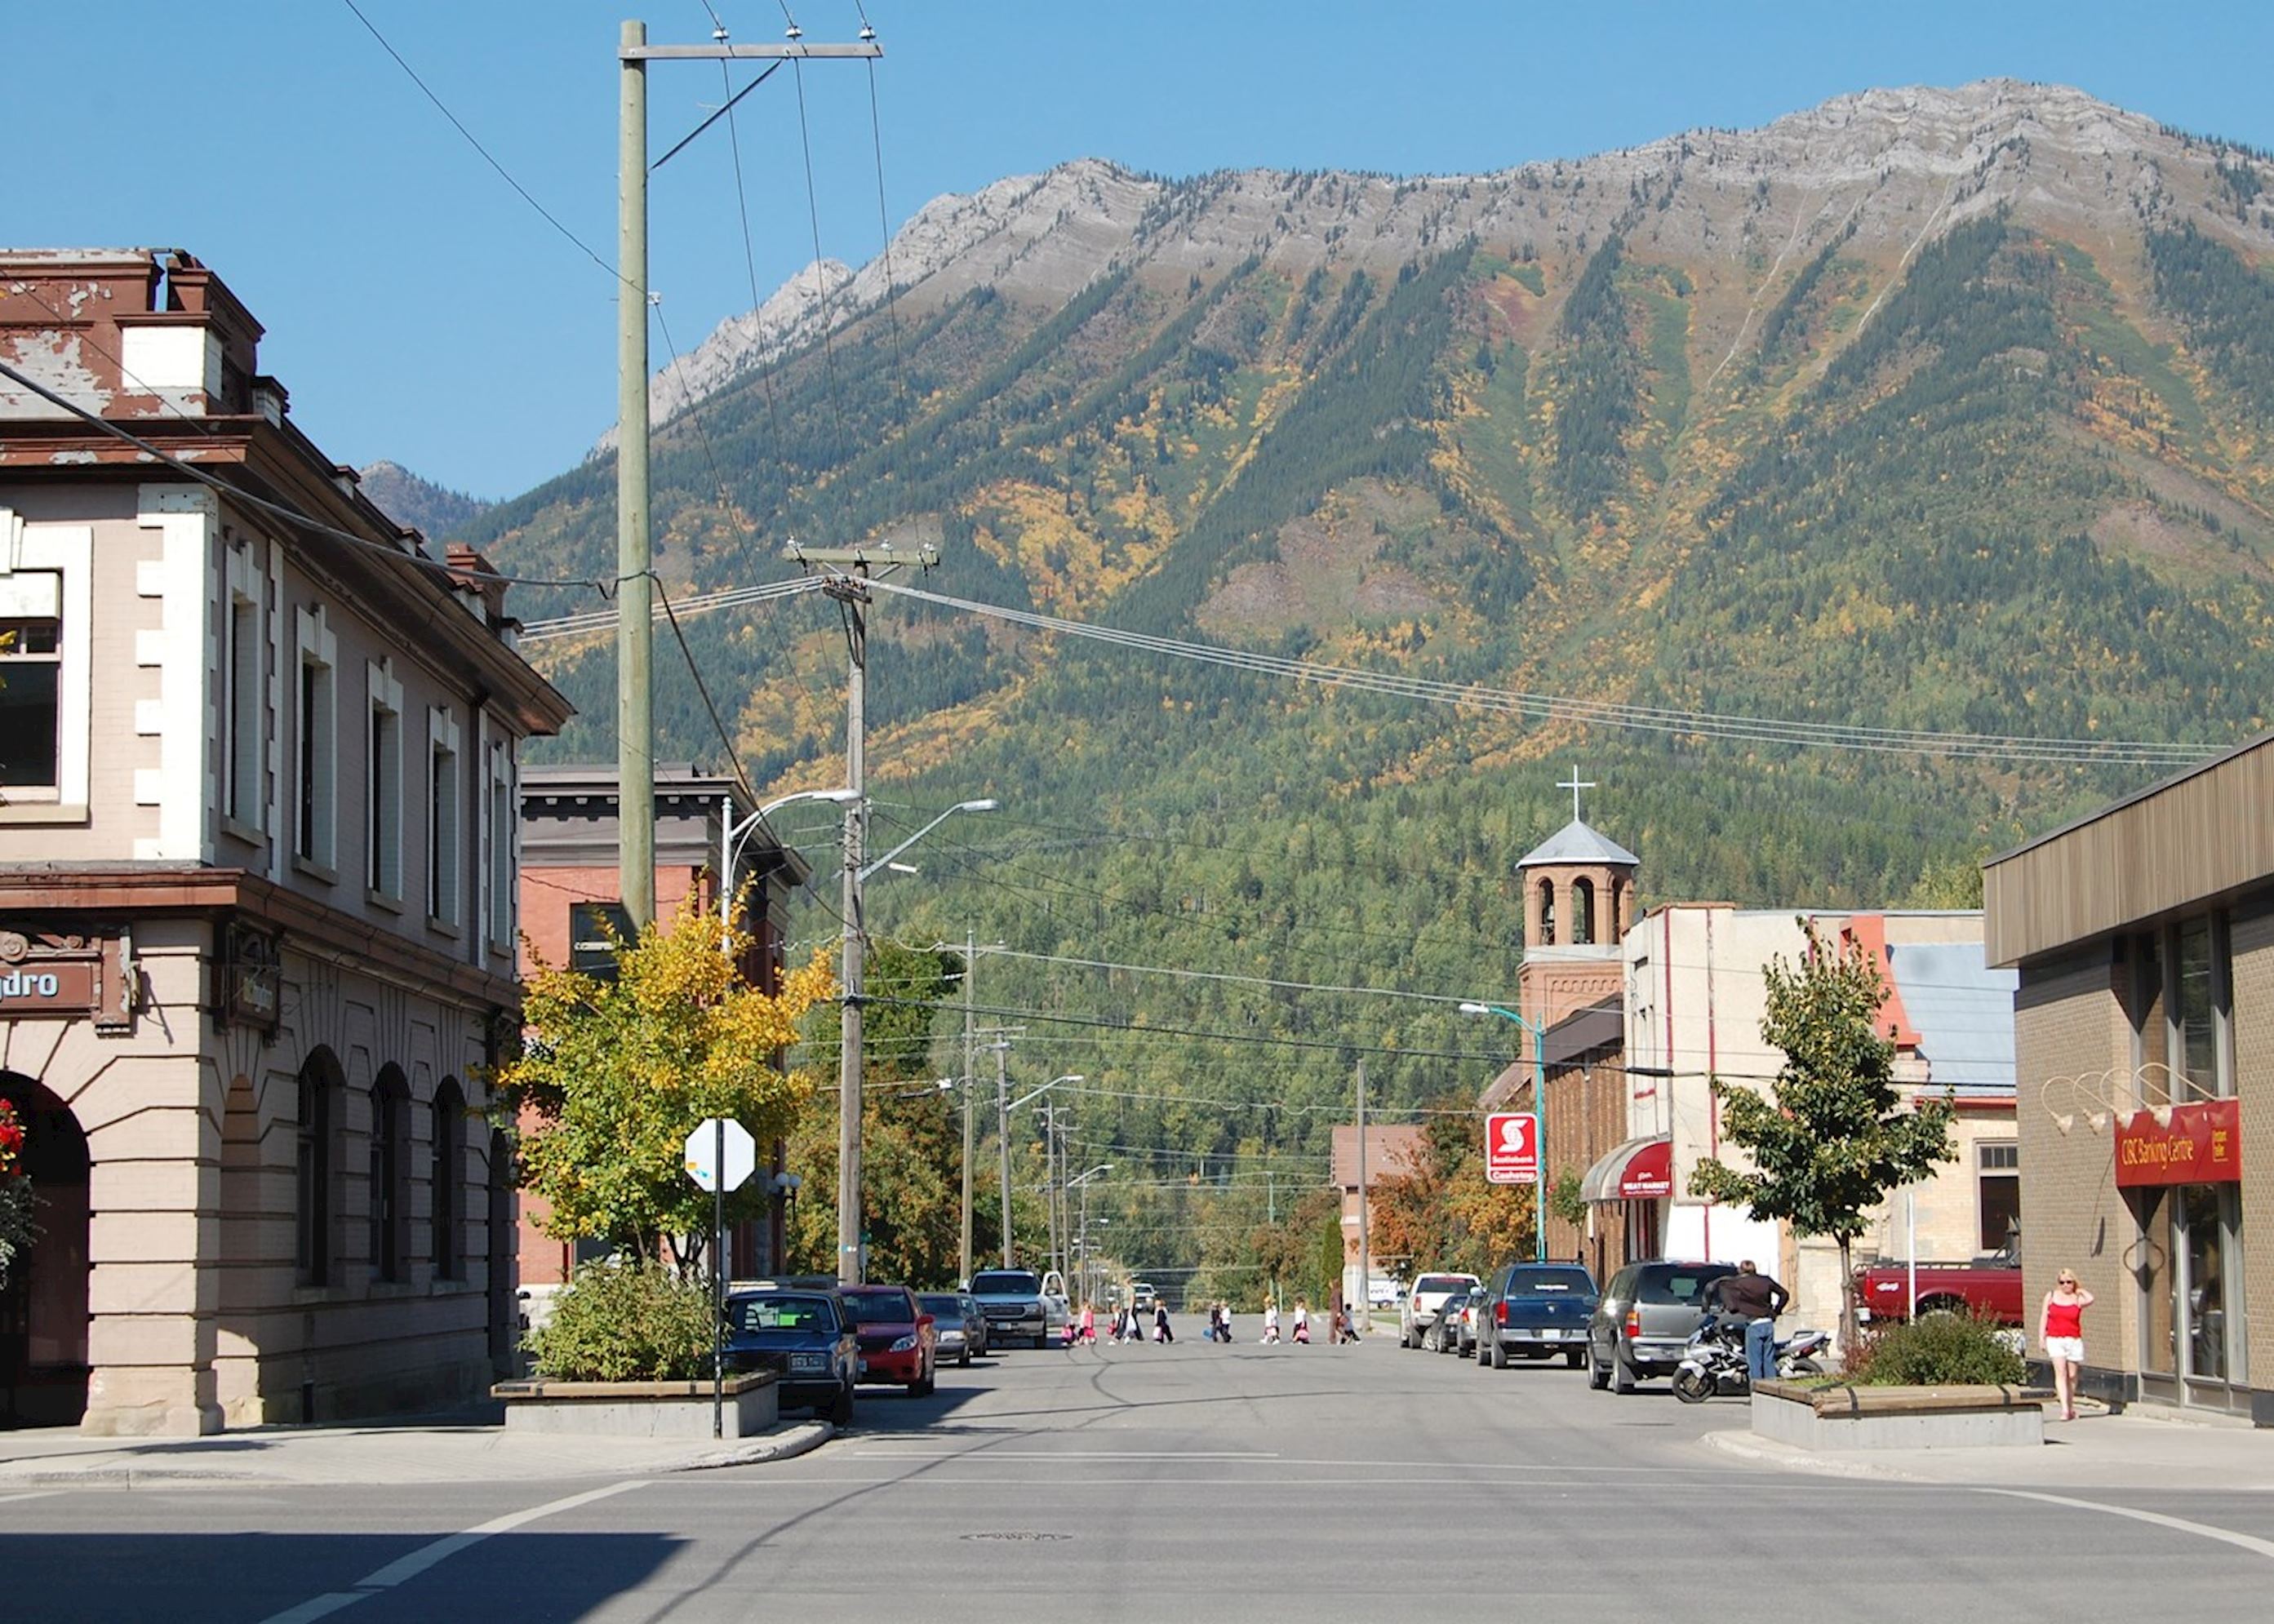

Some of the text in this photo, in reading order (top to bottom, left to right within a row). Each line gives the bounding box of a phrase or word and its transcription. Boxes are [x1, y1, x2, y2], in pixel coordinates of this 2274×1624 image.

[0, 970, 58, 1002] dro
[2139, 1135, 2167, 1169] Banking
[2168, 1134, 2194, 1163] Centre
